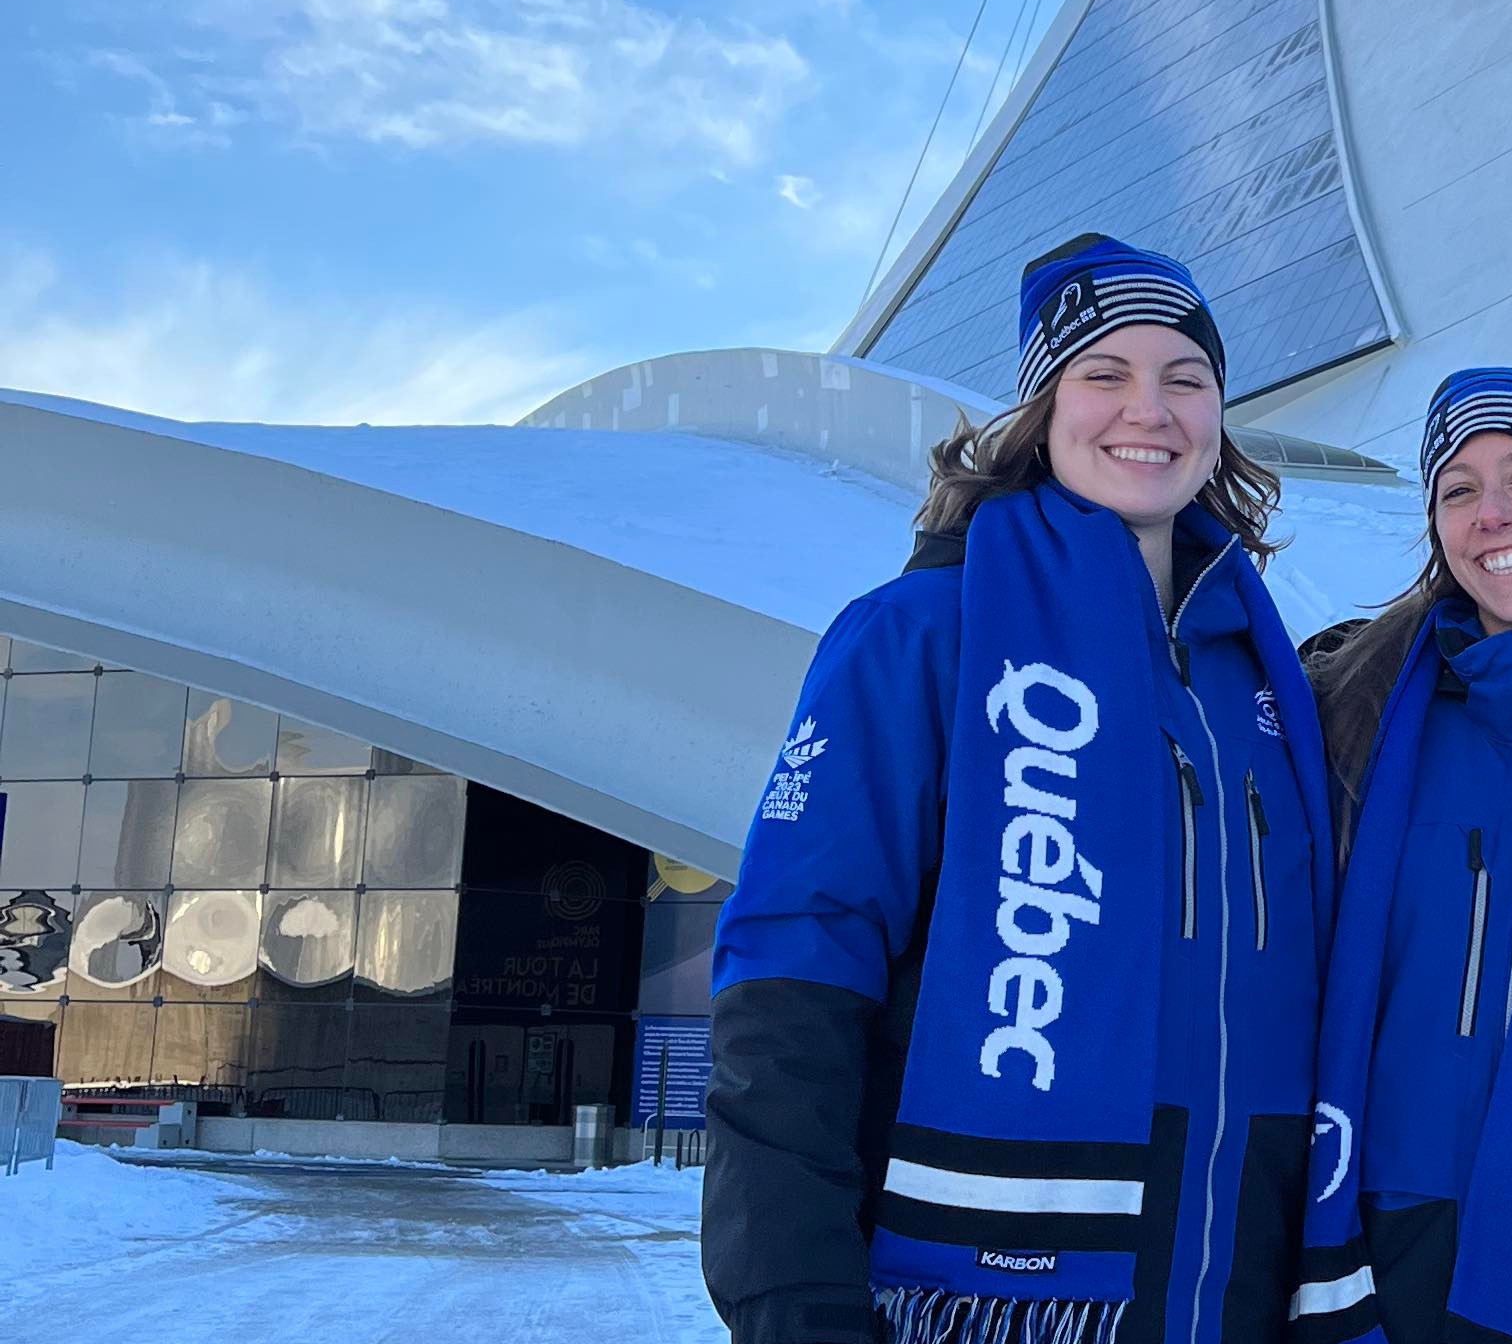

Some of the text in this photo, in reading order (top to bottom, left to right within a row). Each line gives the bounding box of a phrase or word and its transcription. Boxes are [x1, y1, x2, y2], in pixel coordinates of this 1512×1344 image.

[792, 791, 808, 802] DU
[762, 800, 804, 812] CANADA
[762, 810, 799, 821] GAMES
[980, 659, 1103, 1092] Québec
[982, 1251, 1056, 1270] KARBON
